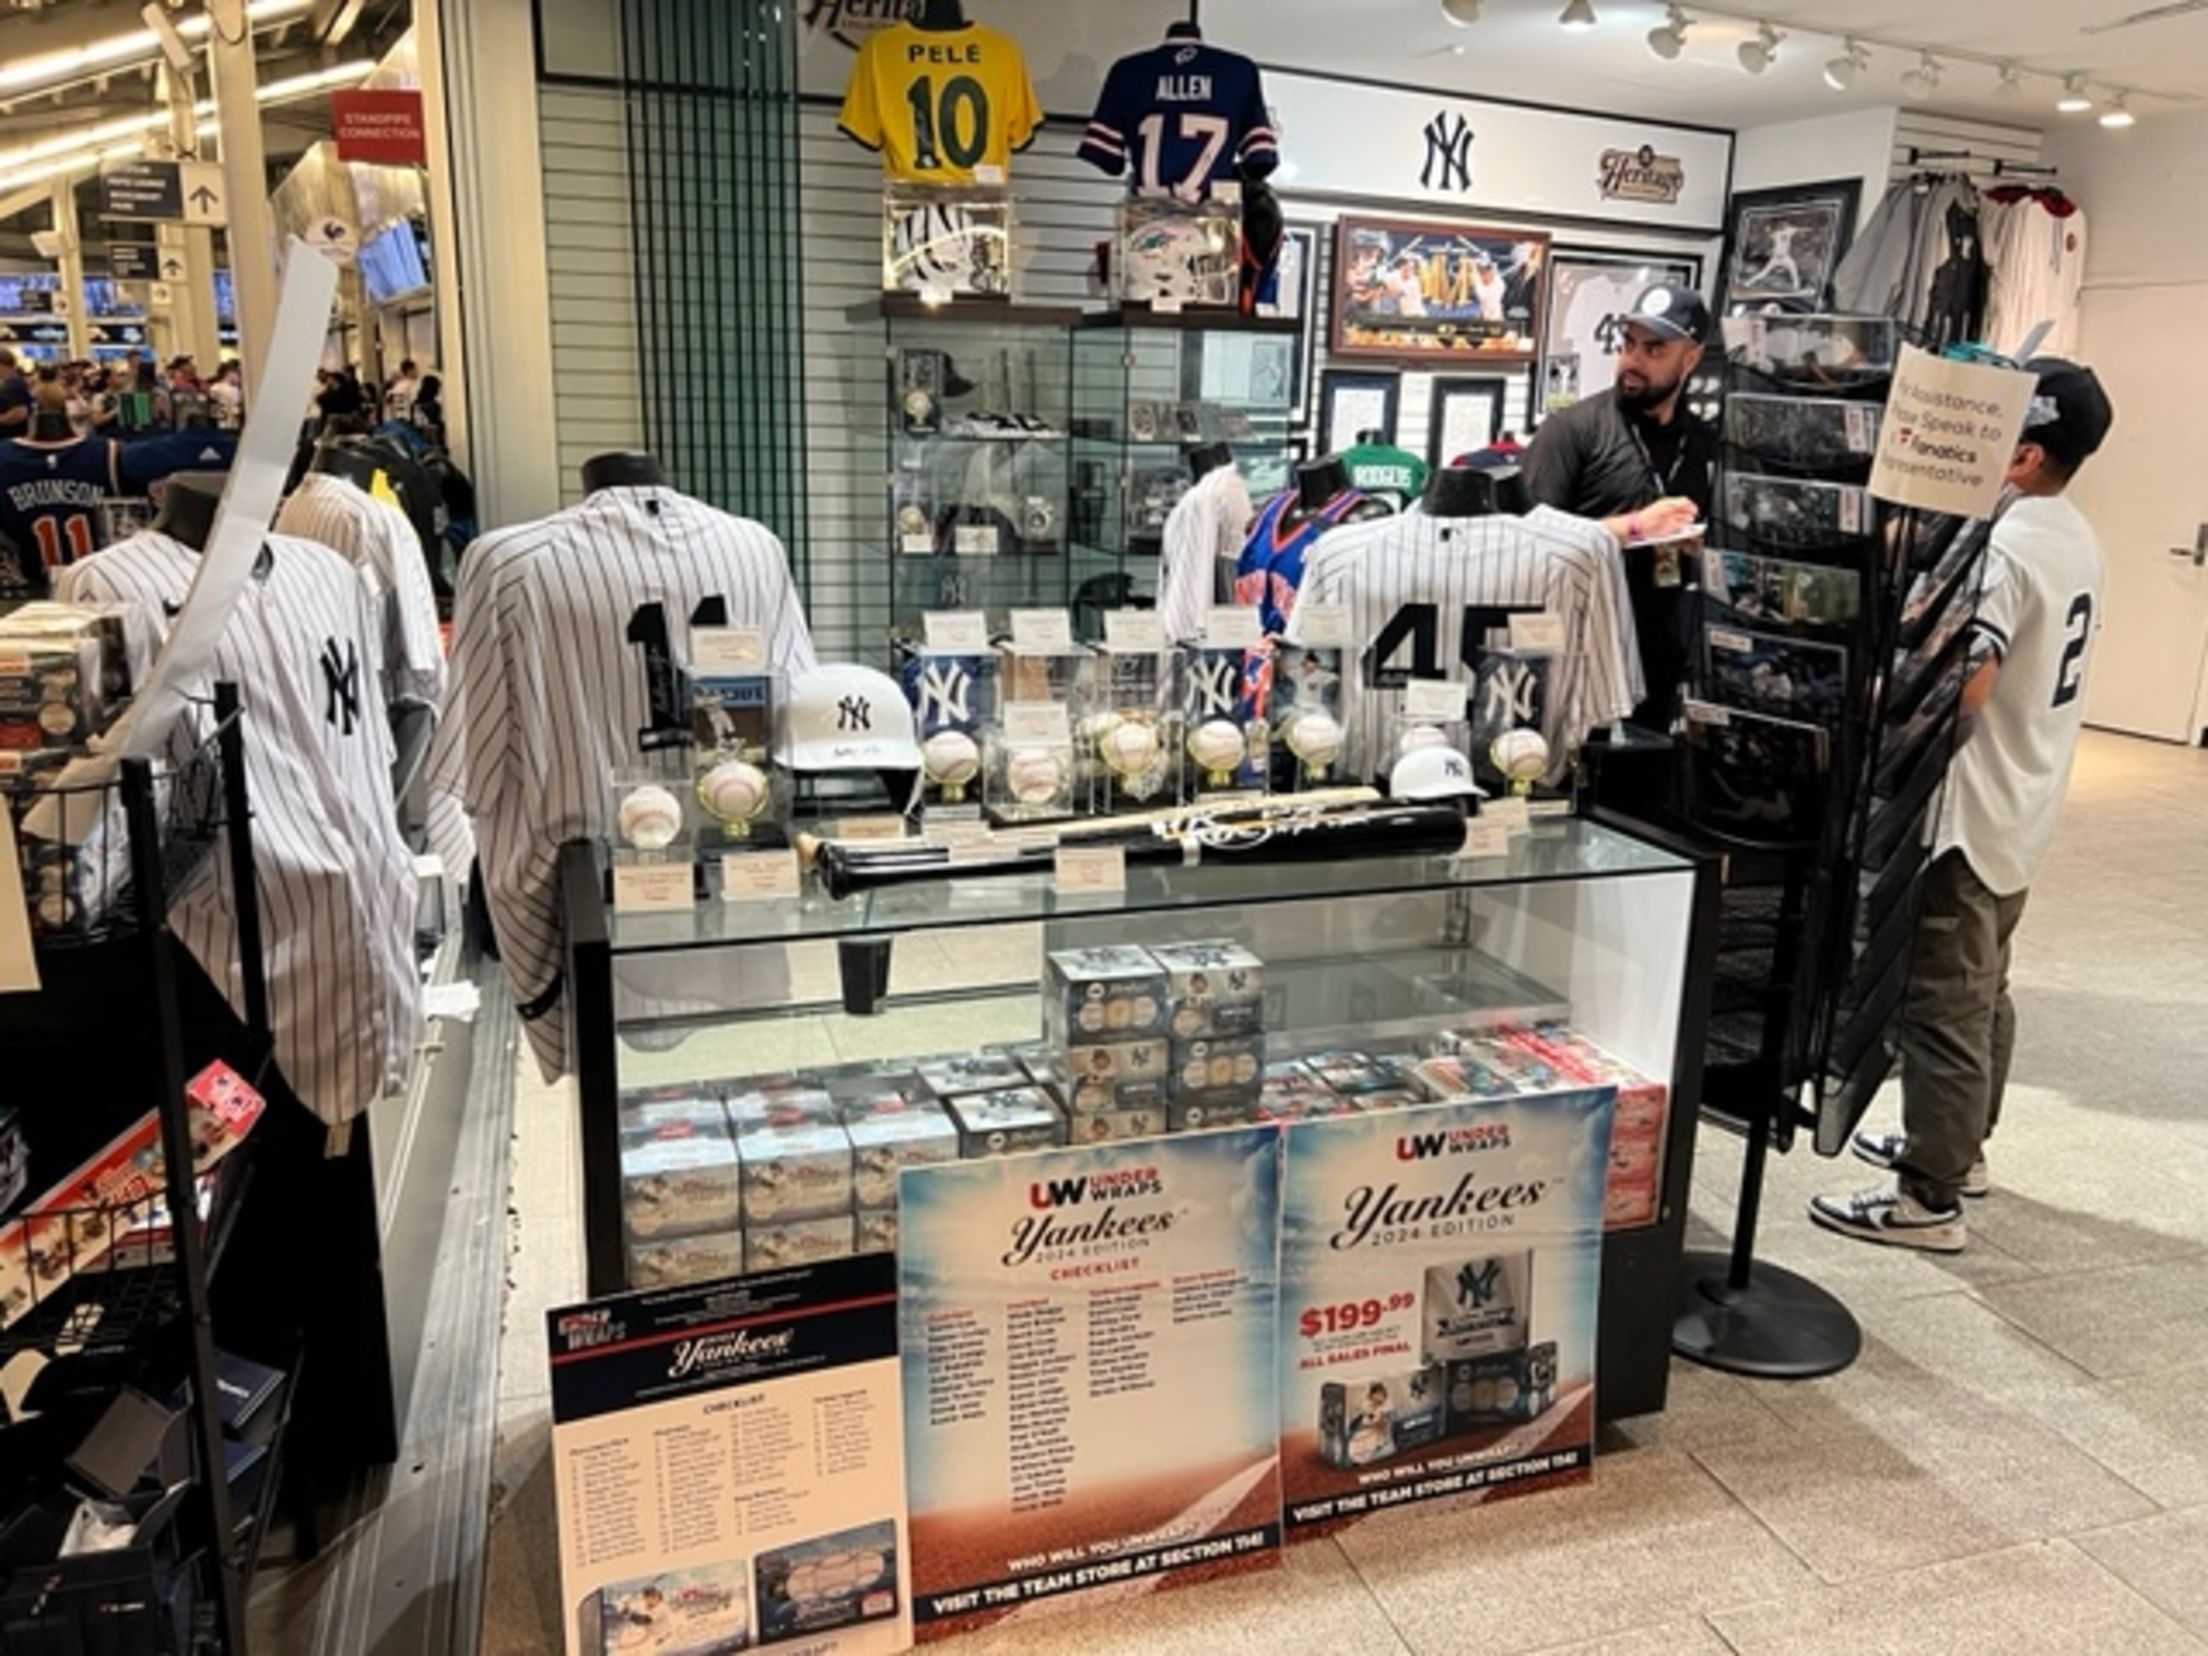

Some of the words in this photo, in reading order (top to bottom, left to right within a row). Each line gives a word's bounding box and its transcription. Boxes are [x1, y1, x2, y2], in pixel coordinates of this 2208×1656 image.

[1155, 75, 1213, 101] ALLEN
[338, 126, 421, 140] CONNECTION
[345, 112, 411, 125] STANDPIPE
[907, 75, 989, 169] 10
[1138, 113, 1229, 203] 17
[1419, 109, 1475, 192] NY
[1911, 434, 1977, 463] fanatics
[1980, 424, 2002, 442] to
[6, 480, 104, 511] BRUNSON
[31, 513, 93, 568] 11
[319, 636, 360, 736] NY
[627, 593, 728, 753] 1
[1184, 653, 1236, 718] NY
[914, 659, 972, 726] NY
[1485, 661, 1537, 728] NY
[837, 695, 871, 731] NY
[1396, 1131, 1446, 1160] UW
[1449, 1124, 1509, 1142] UNDER
[1449, 1135, 1512, 1154] WRAPS
[1030, 1176, 1087, 1209] UW
[1090, 1166, 1158, 1187] UNDER
[1090, 1179, 1162, 1201] WRAPS
[1330, 1172, 1546, 1250] Yankees
[1001, 1206, 1174, 1267] Yankees
[1372, 1228, 1421, 1246] 2024
[1431, 1213, 1515, 1238] EDITION
[1083, 1238, 1150, 1256] EDITION
[1050, 1257, 1140, 1281] CHECKLIST
[1457, 1258, 1501, 1309] NY
[668, 1330, 790, 1377] Yankees
[1327, 1349, 1371, 1364] SALES
[1373, 1342, 1412, 1357] FINAL
[1369, 1486, 1413, 1506] TEAM
[1415, 1474, 1463, 1496] STORE
[1466, 1470, 1485, 1487] AT
[1487, 1455, 1550, 1481] SECTION
[1007, 1553, 1046, 1571] WHO
[1049, 1546, 1085, 1563] WILL
[1089, 1539, 1118, 1555] YOU
[932, 1590, 980, 1614] VISIT
[983, 1583, 1019, 1604] THE
[1023, 1572, 1073, 1595] TEAM
[1076, 1559, 1132, 1583] STORE
[1135, 1555, 1157, 1573] AT
[1160, 1538, 1233, 1566] SECTION
